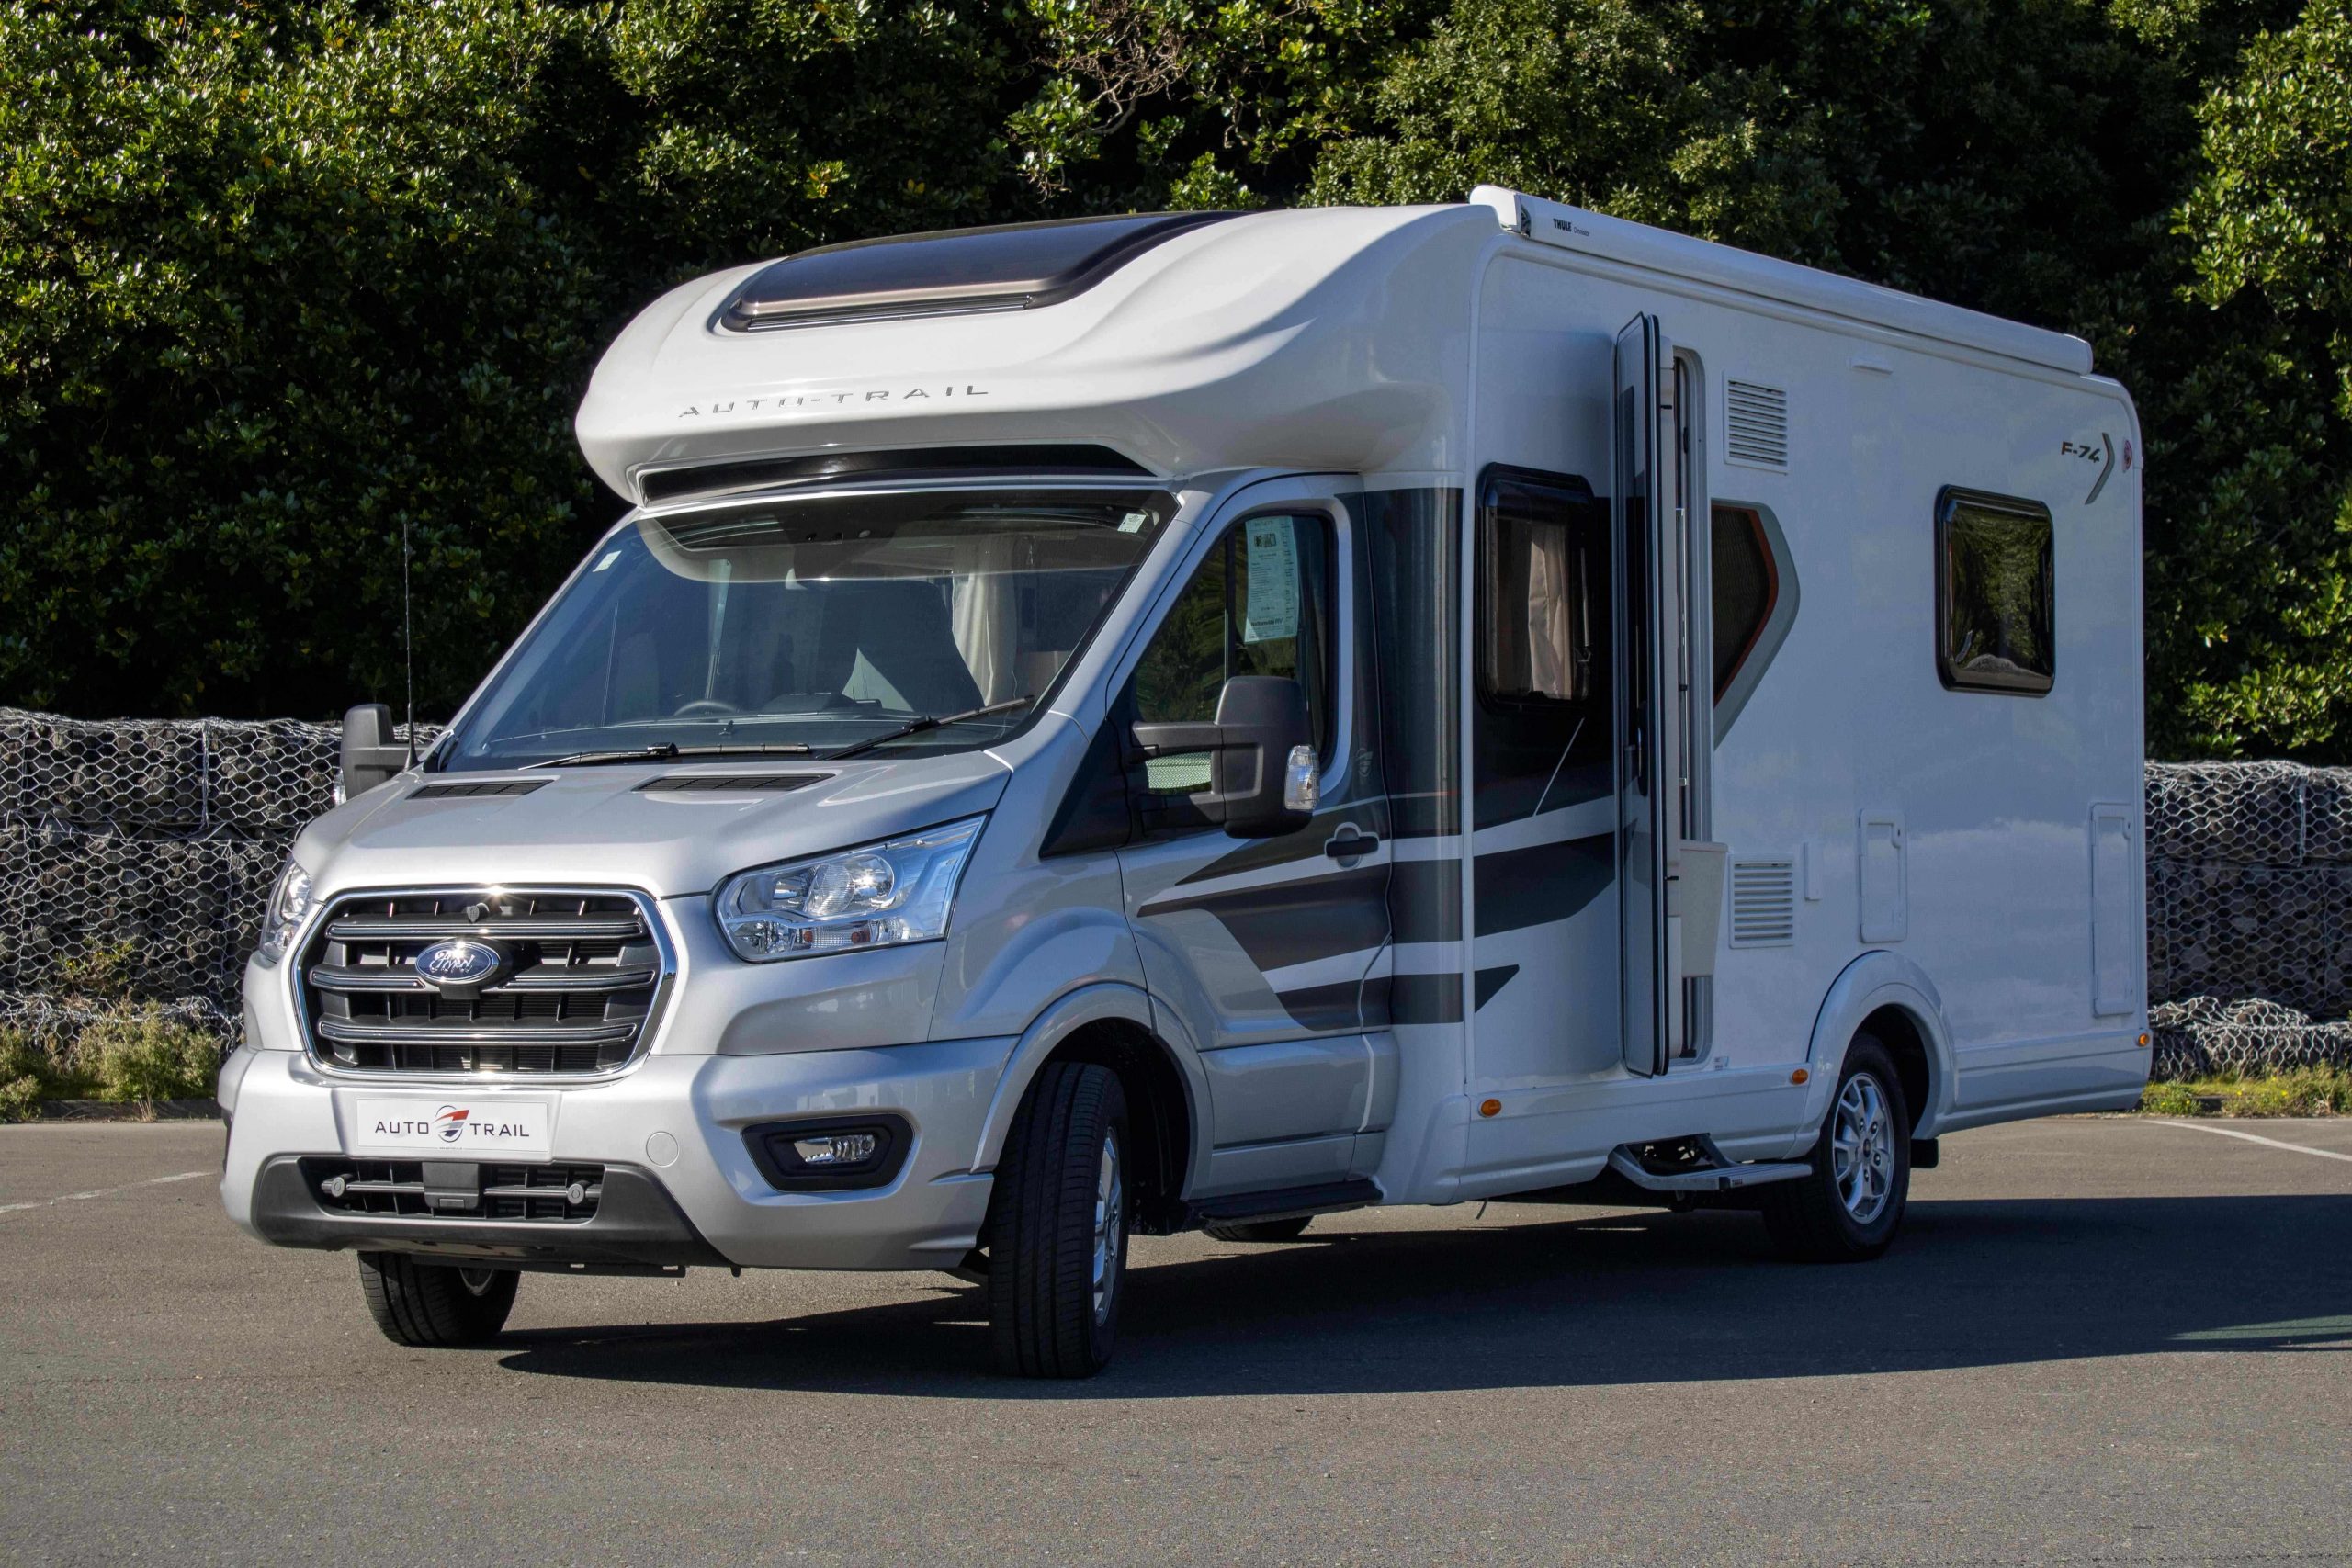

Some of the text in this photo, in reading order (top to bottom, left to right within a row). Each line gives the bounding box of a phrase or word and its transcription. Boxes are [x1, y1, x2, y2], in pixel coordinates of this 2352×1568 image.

[1553, 218, 1572, 232] THULE
[2061, 441, 2101, 464] F-74
[429, 950, 476, 974] Ford
[375, 1121, 530, 1137] AUTO TRAIL
